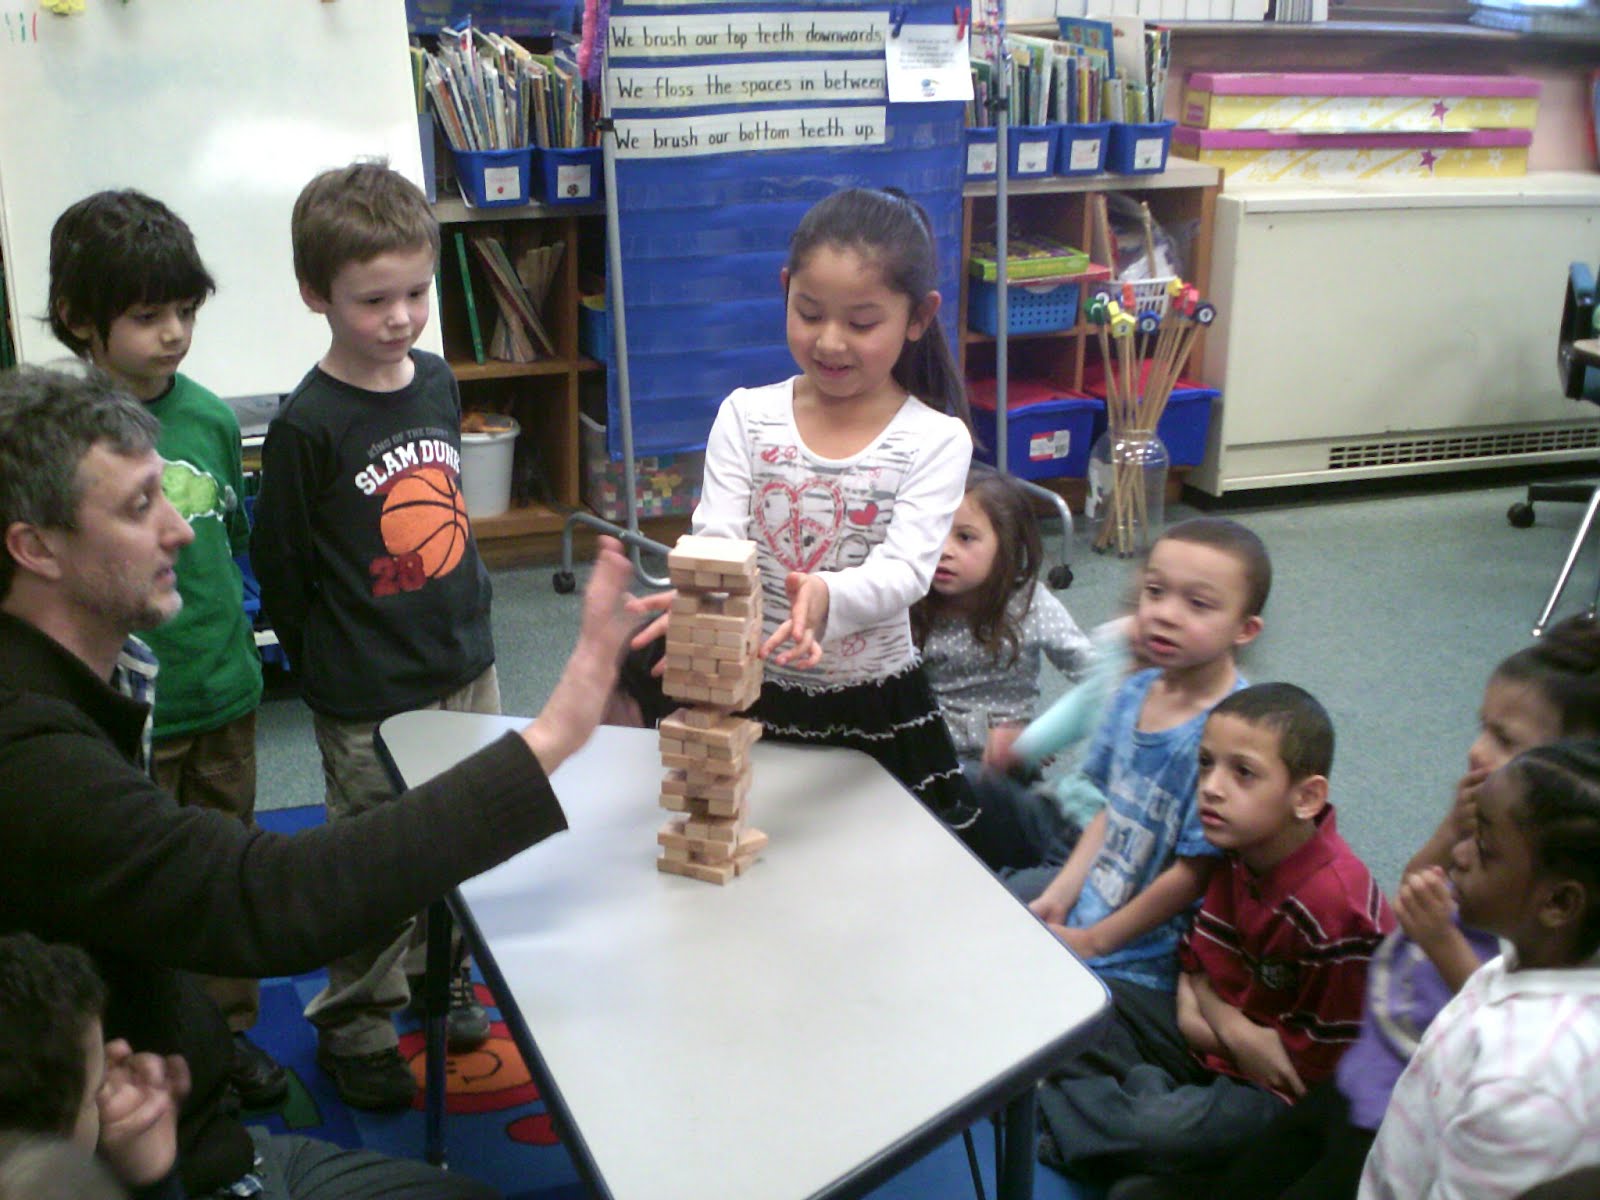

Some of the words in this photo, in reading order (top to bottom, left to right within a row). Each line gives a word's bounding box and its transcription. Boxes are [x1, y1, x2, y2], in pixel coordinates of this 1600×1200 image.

[611, 25, 635, 47] We
[642, 25, 687, 47] brush
[695, 33, 719, 46] our
[727, 23, 748, 50] top
[756, 21, 794, 43] teeth
[617, 76, 643, 98] We
[655, 76, 694, 98] floss
[705, 73, 732, 95] the
[741, 79, 792, 97] spaces
[800, 78, 815, 91] in
[613, 127, 640, 150] We
[653, 126, 698, 149] brush
[708, 132, 730, 145] our
[739, 120, 790, 141] bottom
[799, 118, 844, 138] teeth
[354, 441, 419, 496] SLAM
[419, 439, 461, 474] DUNK
